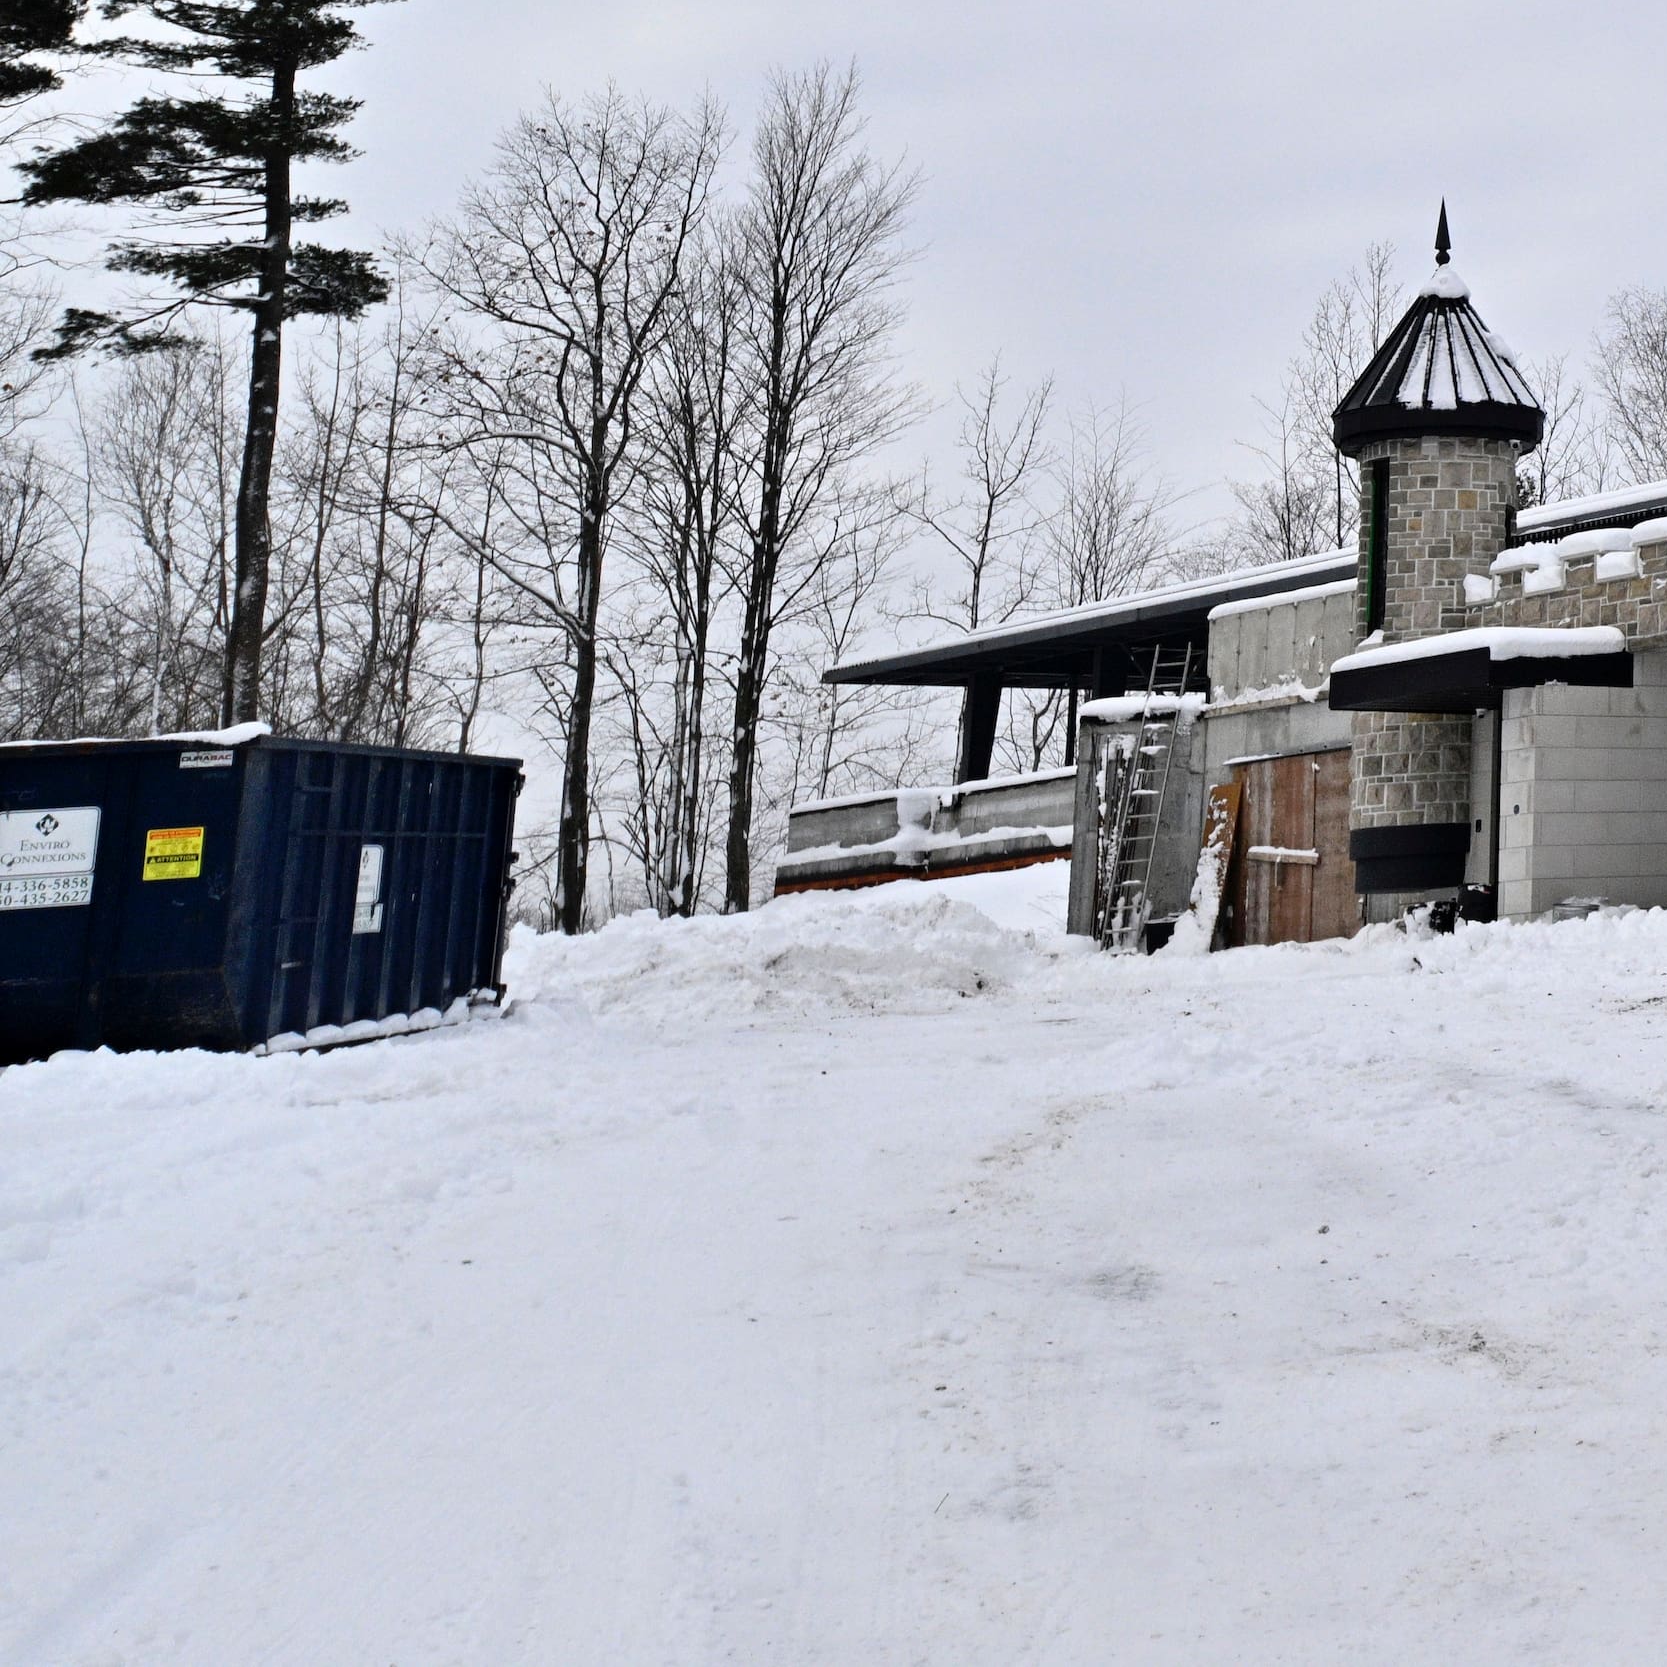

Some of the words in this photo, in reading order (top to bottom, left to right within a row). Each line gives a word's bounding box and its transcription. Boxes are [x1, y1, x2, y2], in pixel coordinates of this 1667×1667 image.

[181, 754, 232, 762] DURABAC
[157, 854, 197, 863] ATTENTION
[0, 877, 88, 894] 14-336-5858
[0, 890, 89, 906] 0-435-2627
